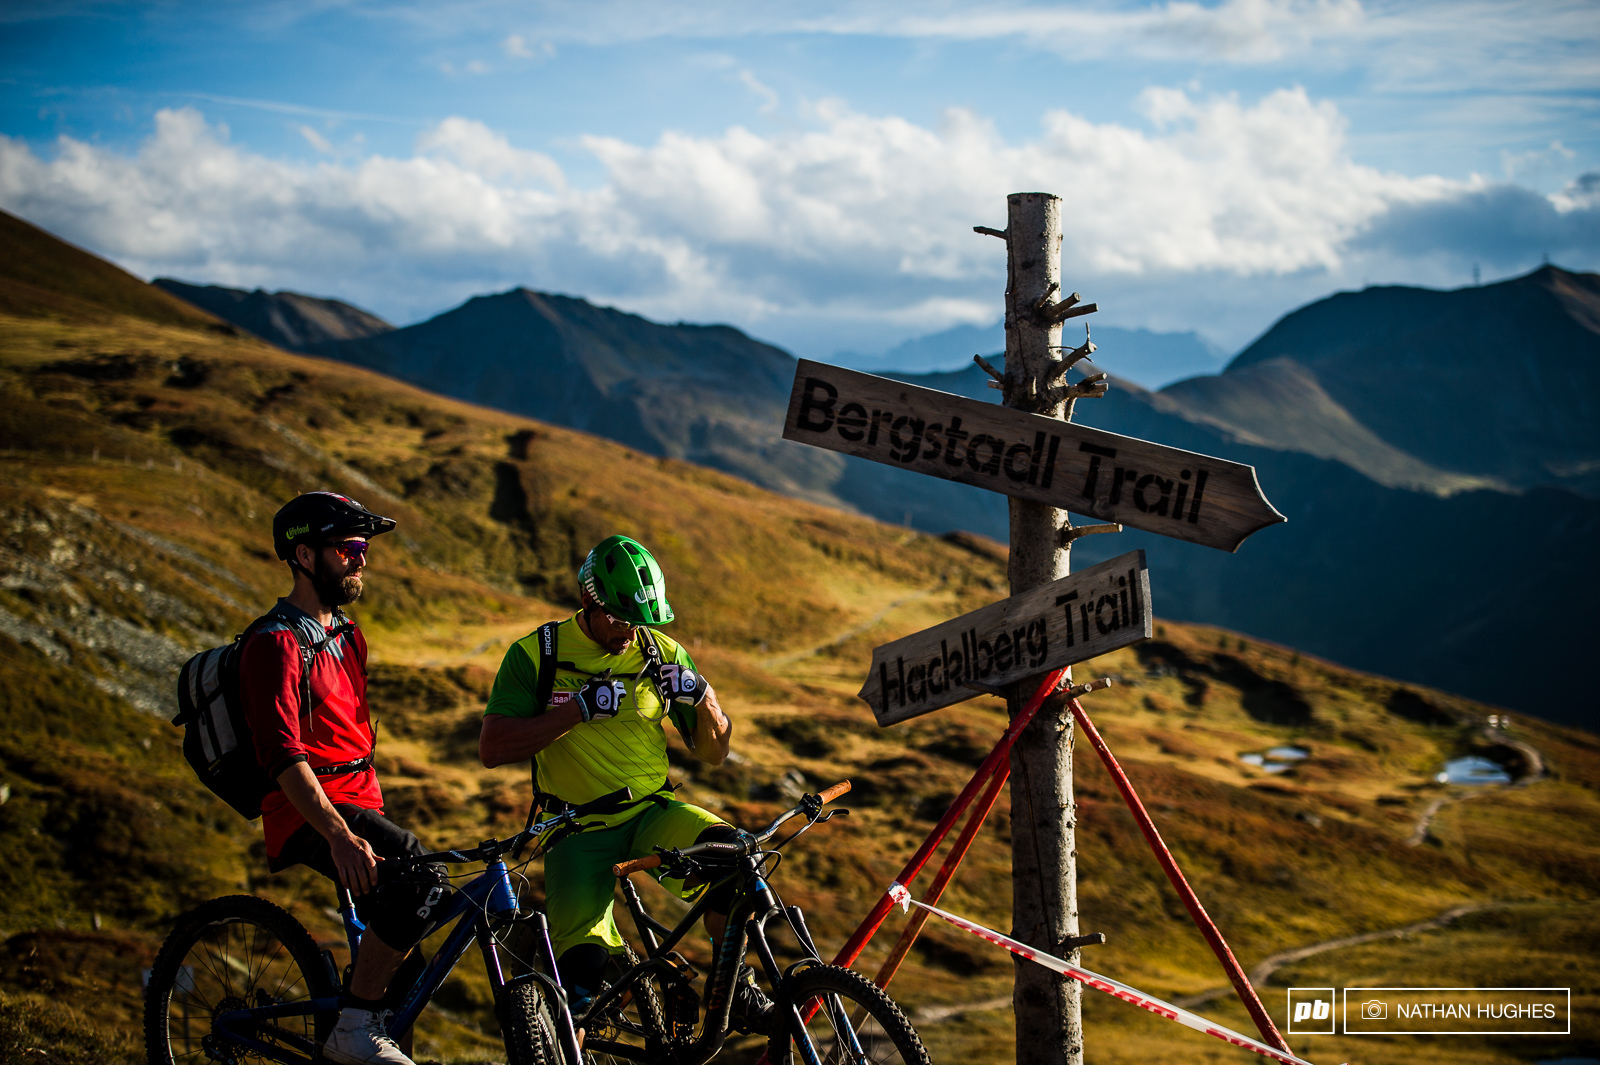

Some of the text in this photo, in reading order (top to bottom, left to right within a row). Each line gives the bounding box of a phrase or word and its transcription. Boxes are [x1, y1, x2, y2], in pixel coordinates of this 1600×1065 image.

[796, 377, 1209, 524] Bergstadl Trail
[544, 625, 552, 656] ERGON
[1055, 568, 1140, 648] Trail
